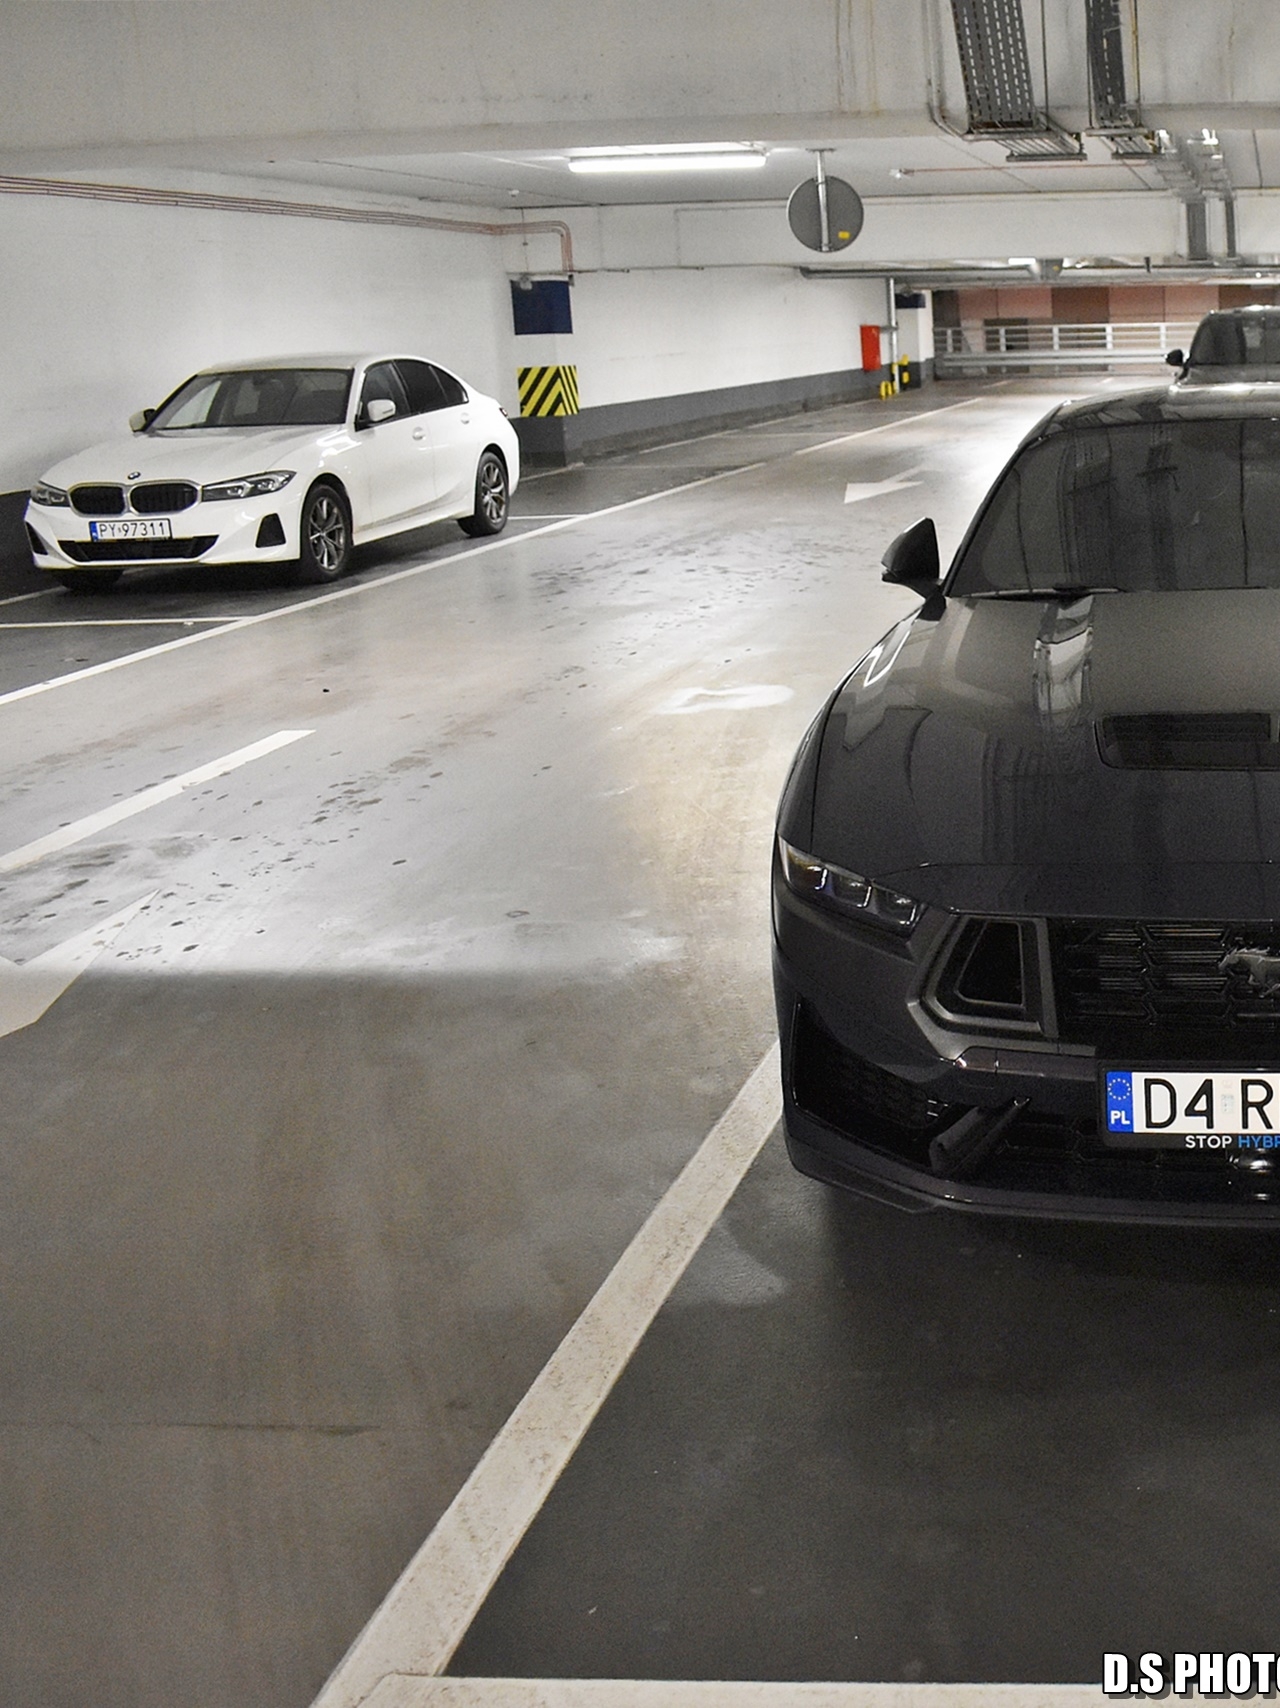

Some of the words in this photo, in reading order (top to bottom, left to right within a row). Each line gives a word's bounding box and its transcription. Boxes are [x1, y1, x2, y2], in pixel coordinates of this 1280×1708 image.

[99, 523, 116, 537] PY
[121, 522, 164, 537] 97311
[1110, 1110, 1130, 1125] PL
[1185, 1135, 1232, 1148] STOP
